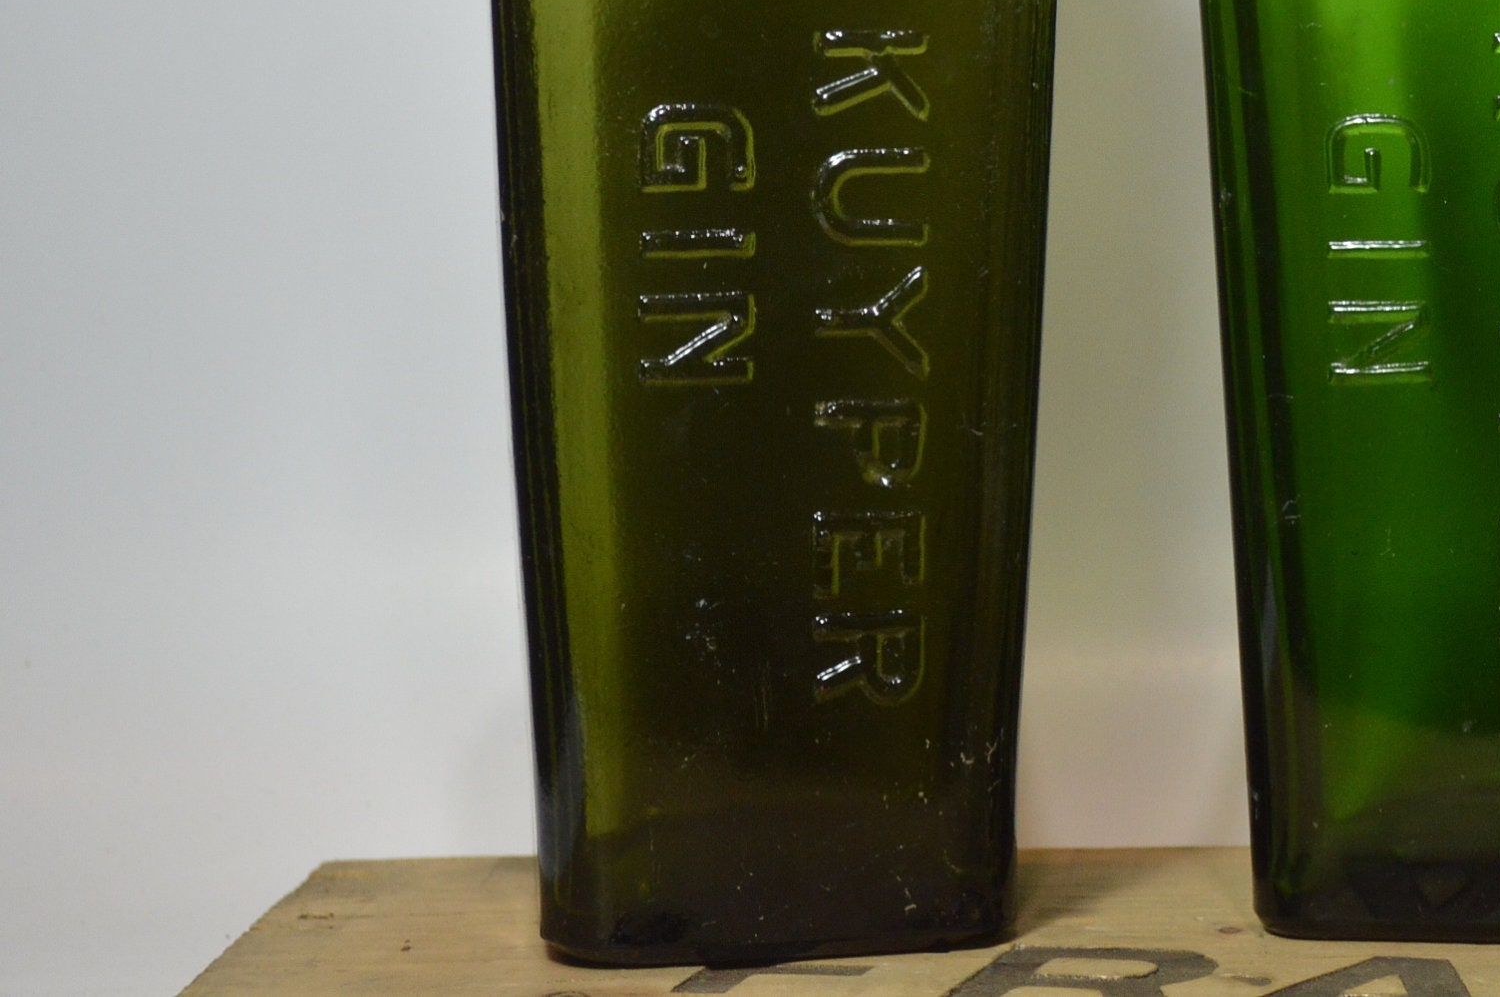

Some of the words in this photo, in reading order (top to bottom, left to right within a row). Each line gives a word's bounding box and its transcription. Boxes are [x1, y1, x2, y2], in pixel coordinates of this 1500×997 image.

[636, 101, 758, 387] GIN
[811, 27, 931, 707] KUYPER
[1323, 111, 1433, 388] GIN
